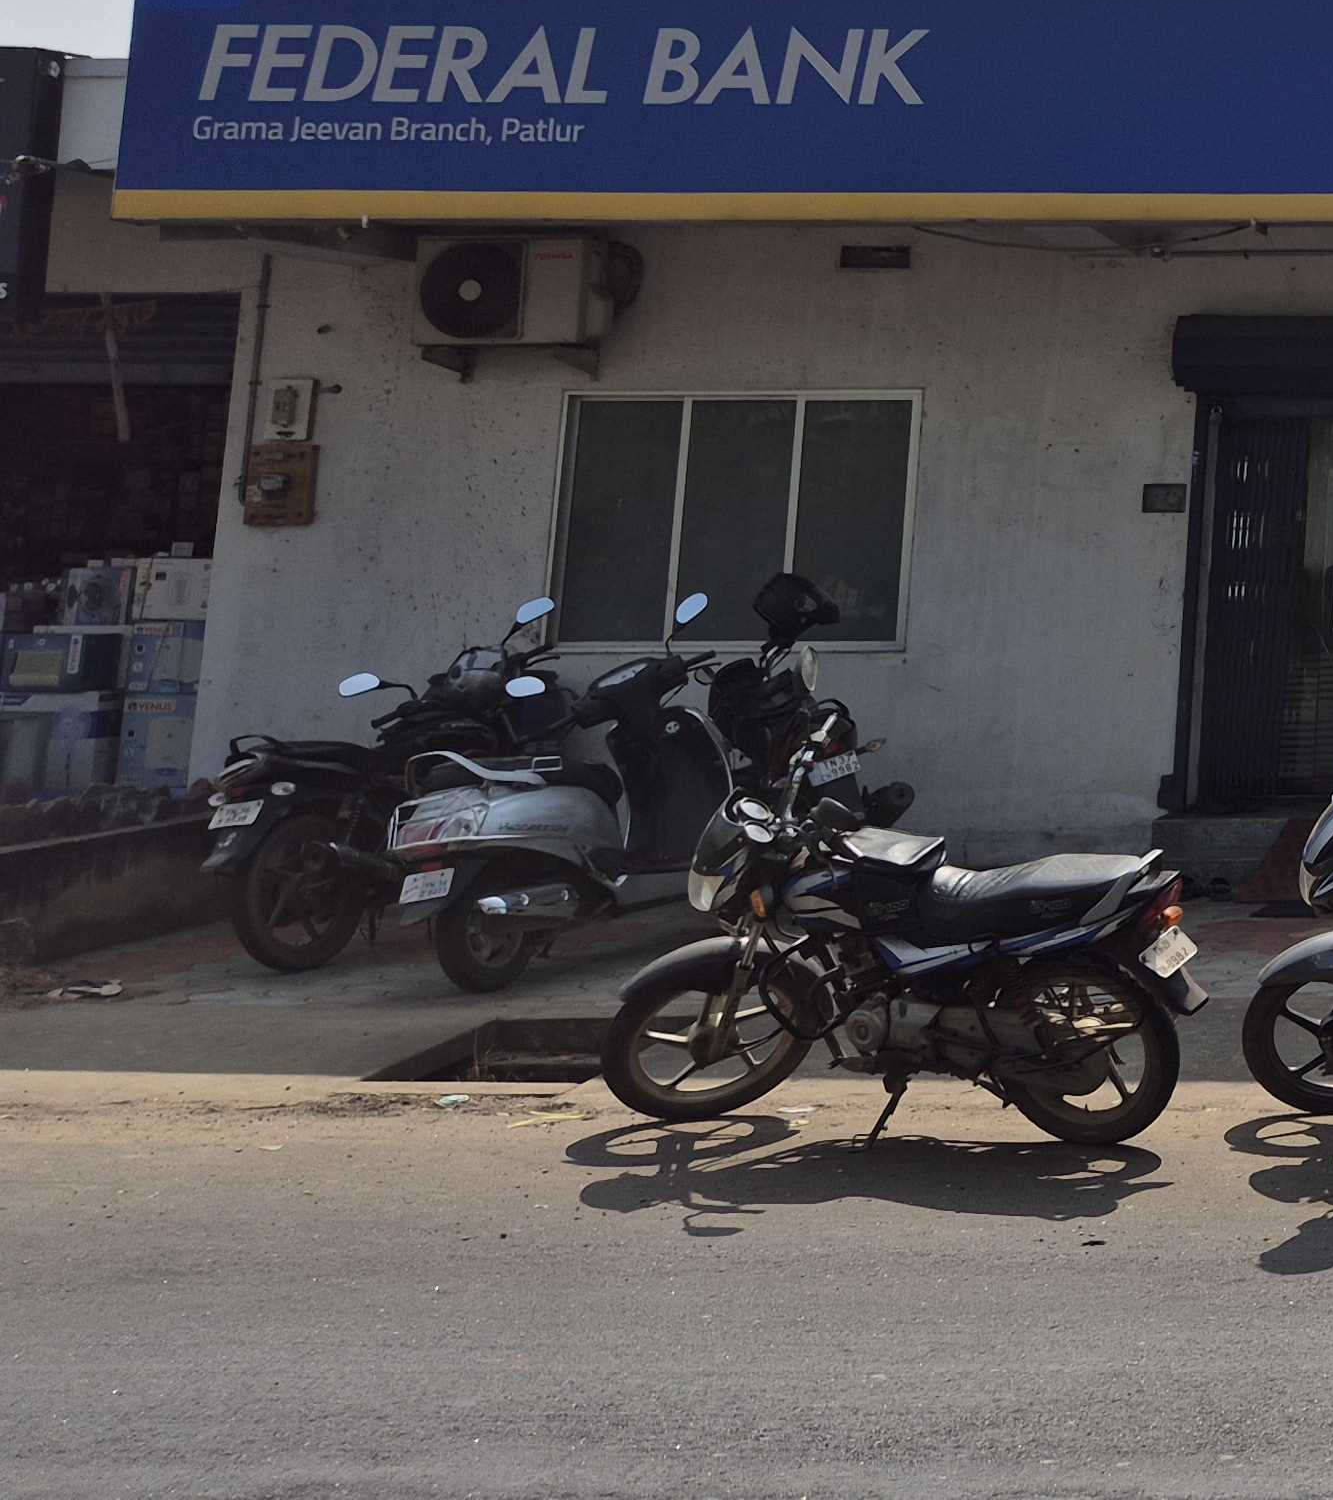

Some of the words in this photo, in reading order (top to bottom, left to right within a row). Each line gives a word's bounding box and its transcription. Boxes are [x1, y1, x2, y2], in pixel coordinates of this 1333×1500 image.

[199, 24, 607, 103] FEDERAL
[643, 26, 930, 105] BANK
[193, 116, 283, 141] Grama
[290, 116, 382, 142] Jeevan
[391, 117, 492, 145] Branch,
[502, 118, 585, 142] Patlur
